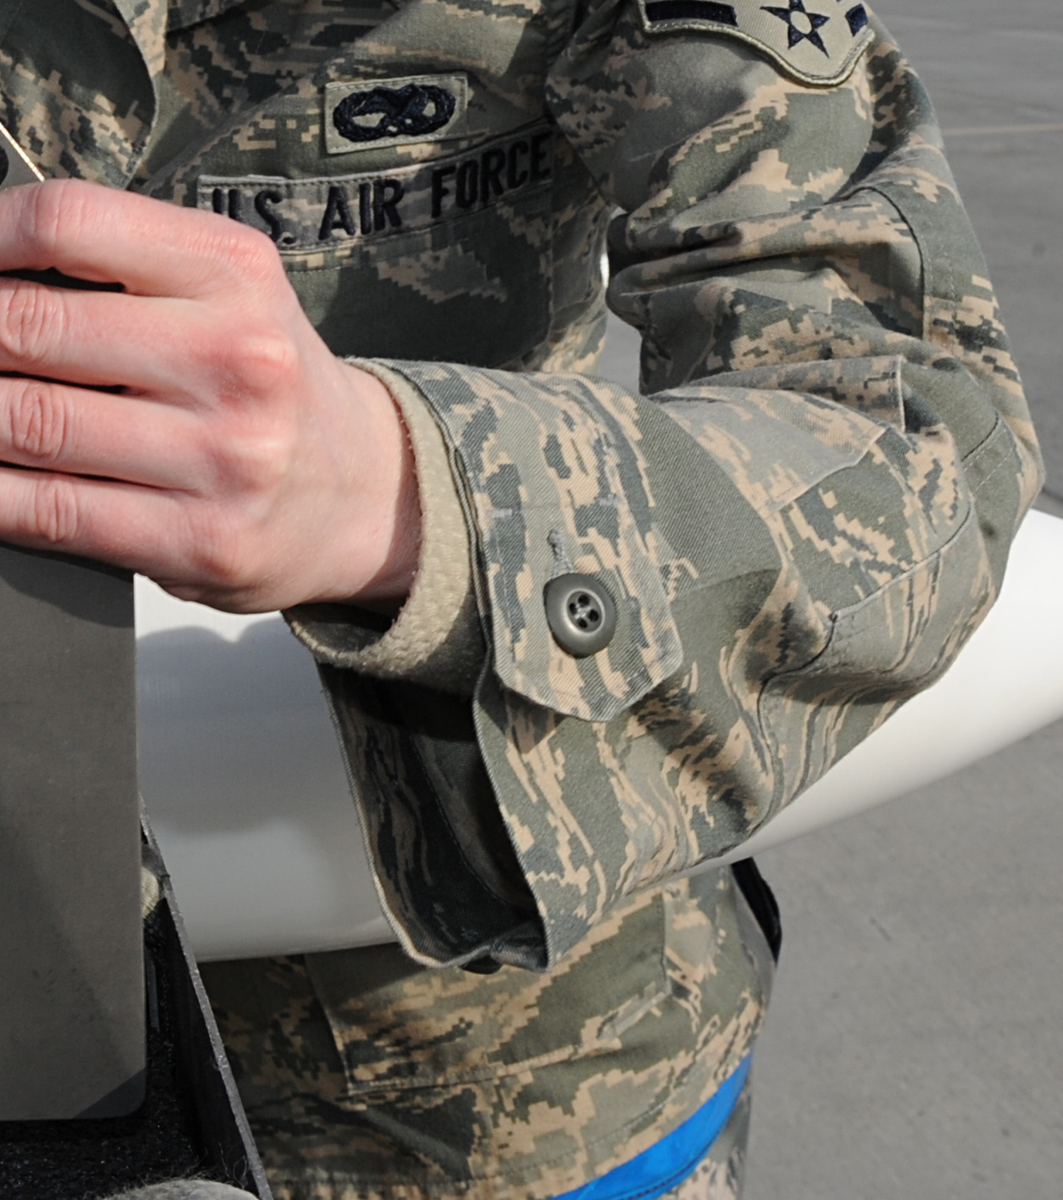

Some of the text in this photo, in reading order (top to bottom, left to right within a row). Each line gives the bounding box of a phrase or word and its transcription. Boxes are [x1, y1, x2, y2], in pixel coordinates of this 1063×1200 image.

[211, 131, 554, 245] US. AIR FORCE
